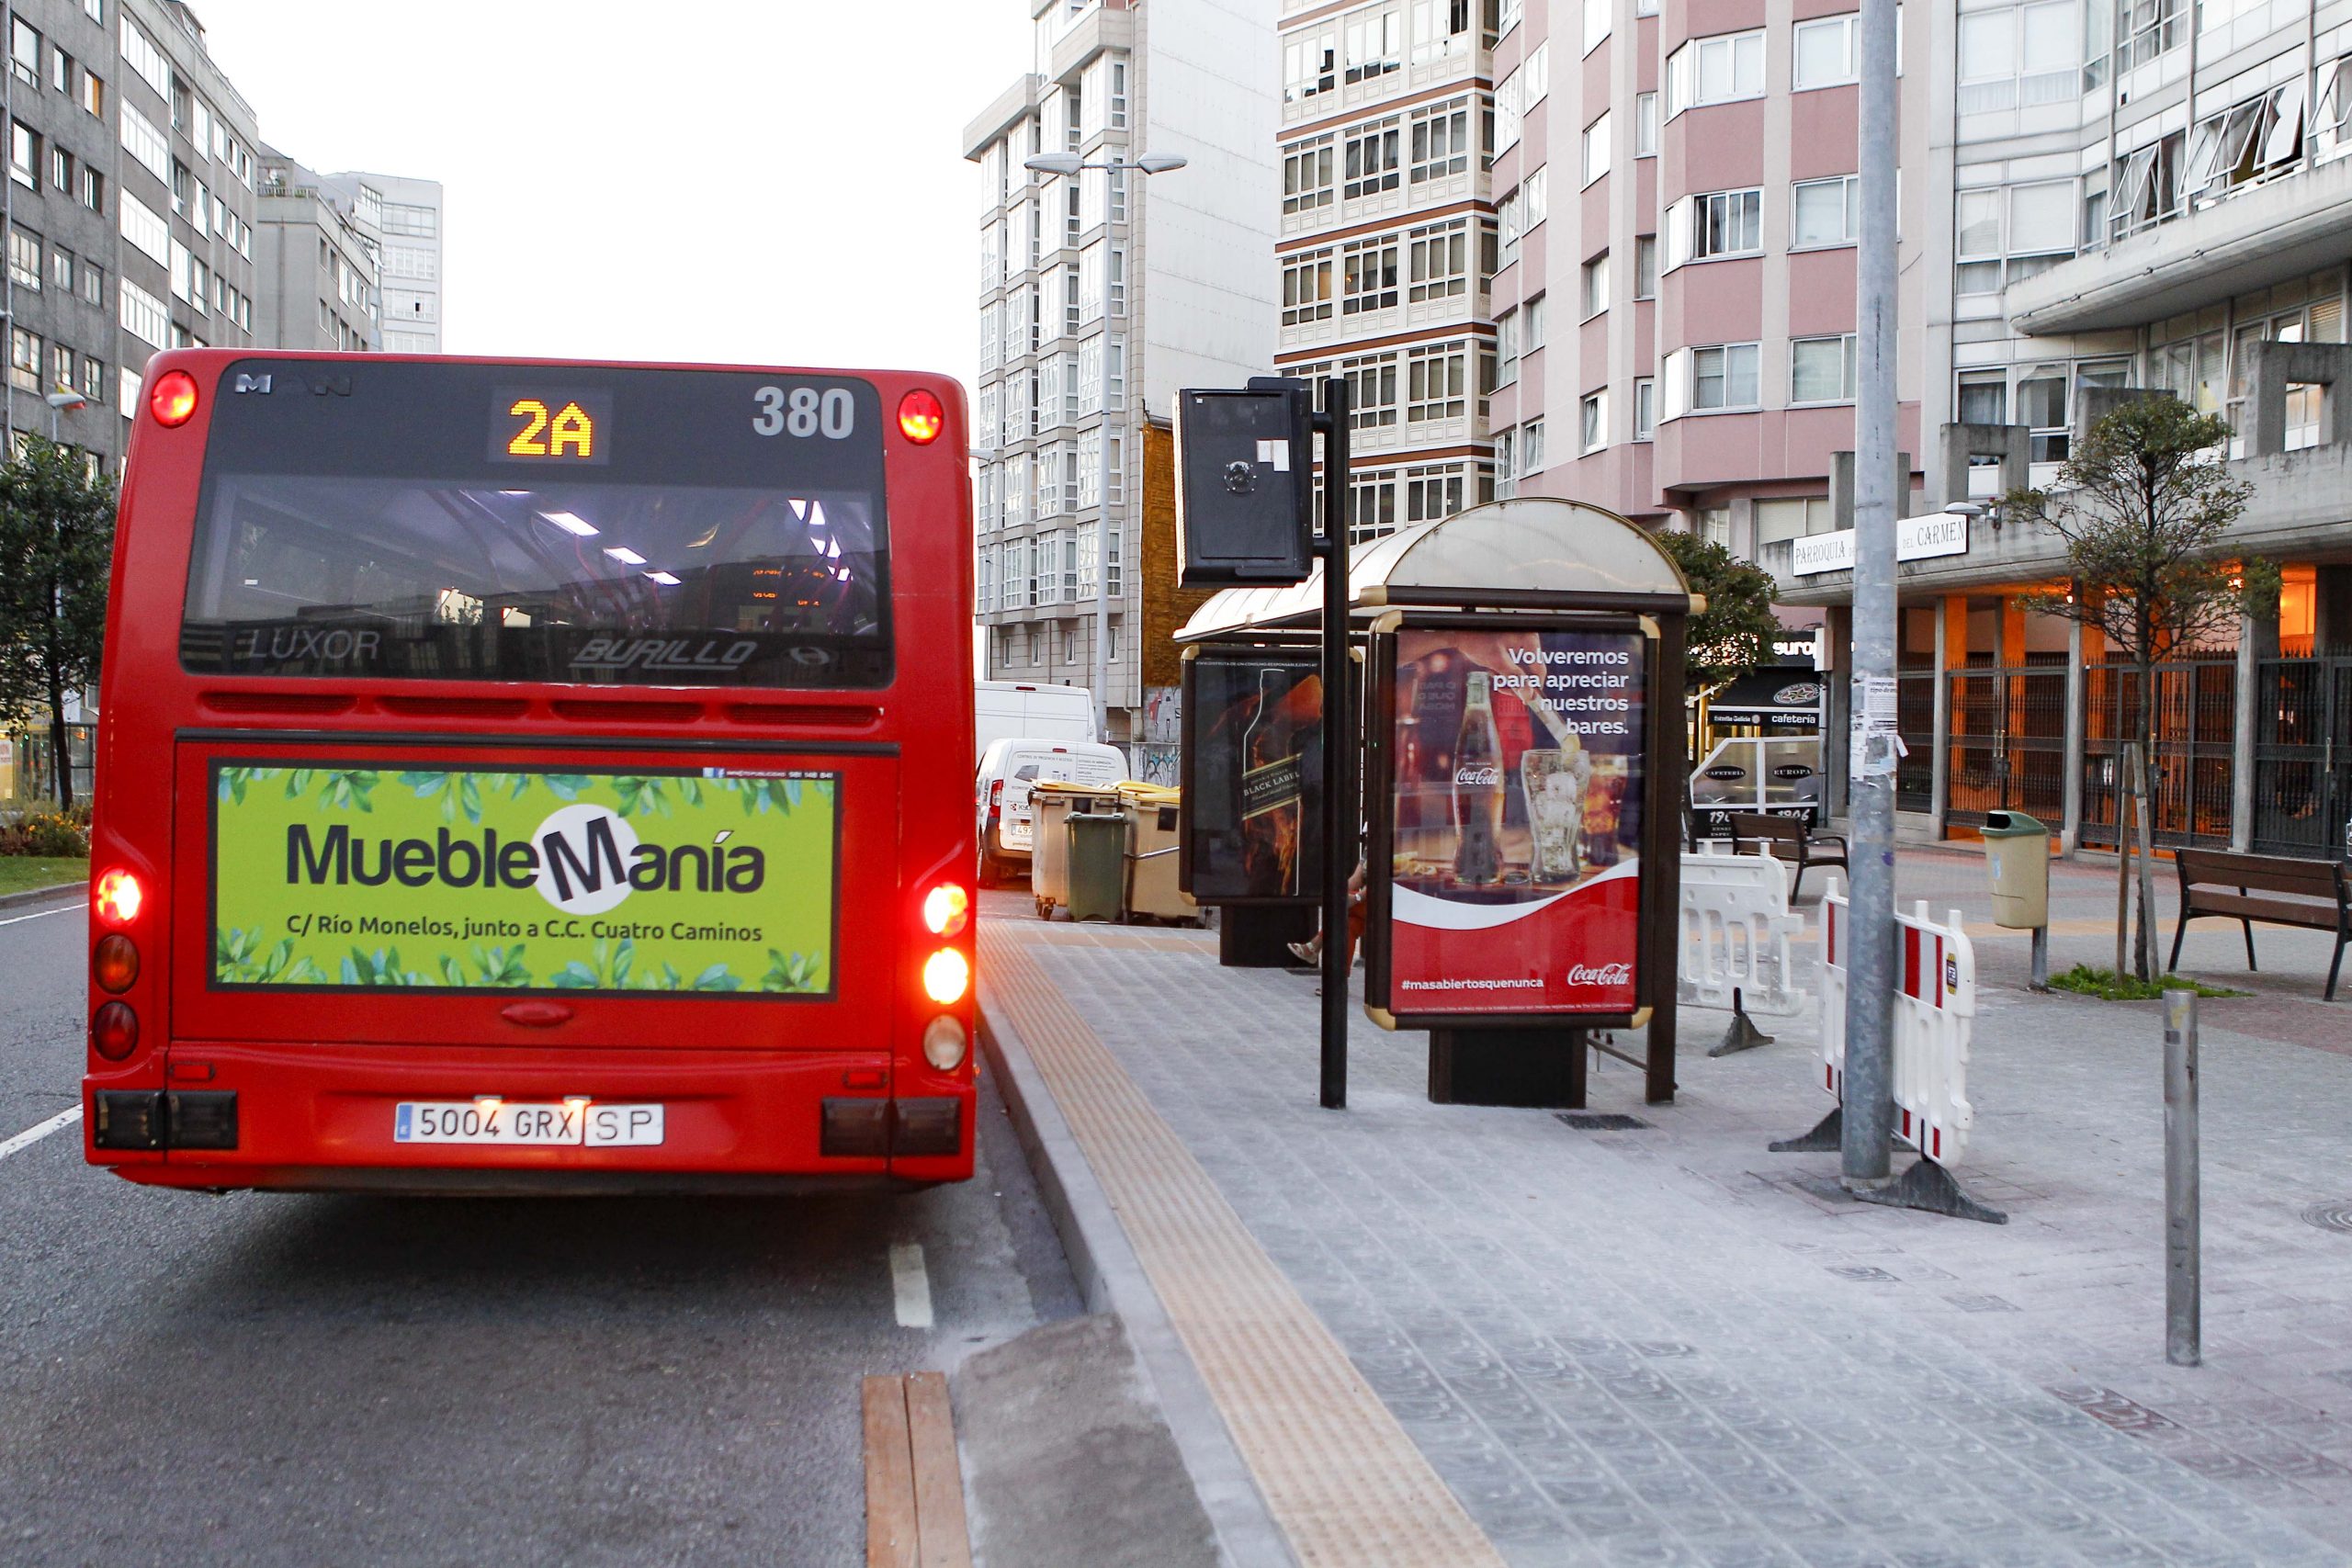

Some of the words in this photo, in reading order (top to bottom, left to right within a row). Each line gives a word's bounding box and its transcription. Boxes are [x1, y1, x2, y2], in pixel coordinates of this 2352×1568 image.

[752, 385, 854, 440] 380
[508, 399, 592, 457] 2A
[1794, 540, 1846, 565] PARROQUIA
[1917, 520, 1965, 546] CARMEN
[249, 629, 380, 660] LUXOR
[568, 638, 758, 671] BURILLO
[1509, 648, 1630, 665] Volveremos
[1493, 673, 1542, 692] para
[1545, 671, 1630, 692] apreciar
[1540, 695, 1630, 712] nuestros
[1566, 717, 1630, 735] bares.
[1771, 714, 1816, 724] cafetería
[1243, 781, 1272, 796] BLACK
[1272, 772, 1300, 785] LABEL
[1455, 768, 1499, 785] Coca-Cola
[287, 816, 764, 902] MuebleManía
[287, 914, 312, 937] C/
[318, 915, 353, 934] Río
[359, 917, 458, 939] Monelos,
[462, 918, 521, 939] junto
[526, 927, 539, 937] a
[545, 920, 585, 938] C.C.
[591, 921, 664, 940] Cuatro
[671, 922, 763, 942] Caminos
[1401, 978, 1544, 990] #masabiertosquenunca
[1567, 963, 1633, 987] Coca-Cola
[421, 1109, 501, 1137] 5004
[515, 1111, 575, 1138] GRX
